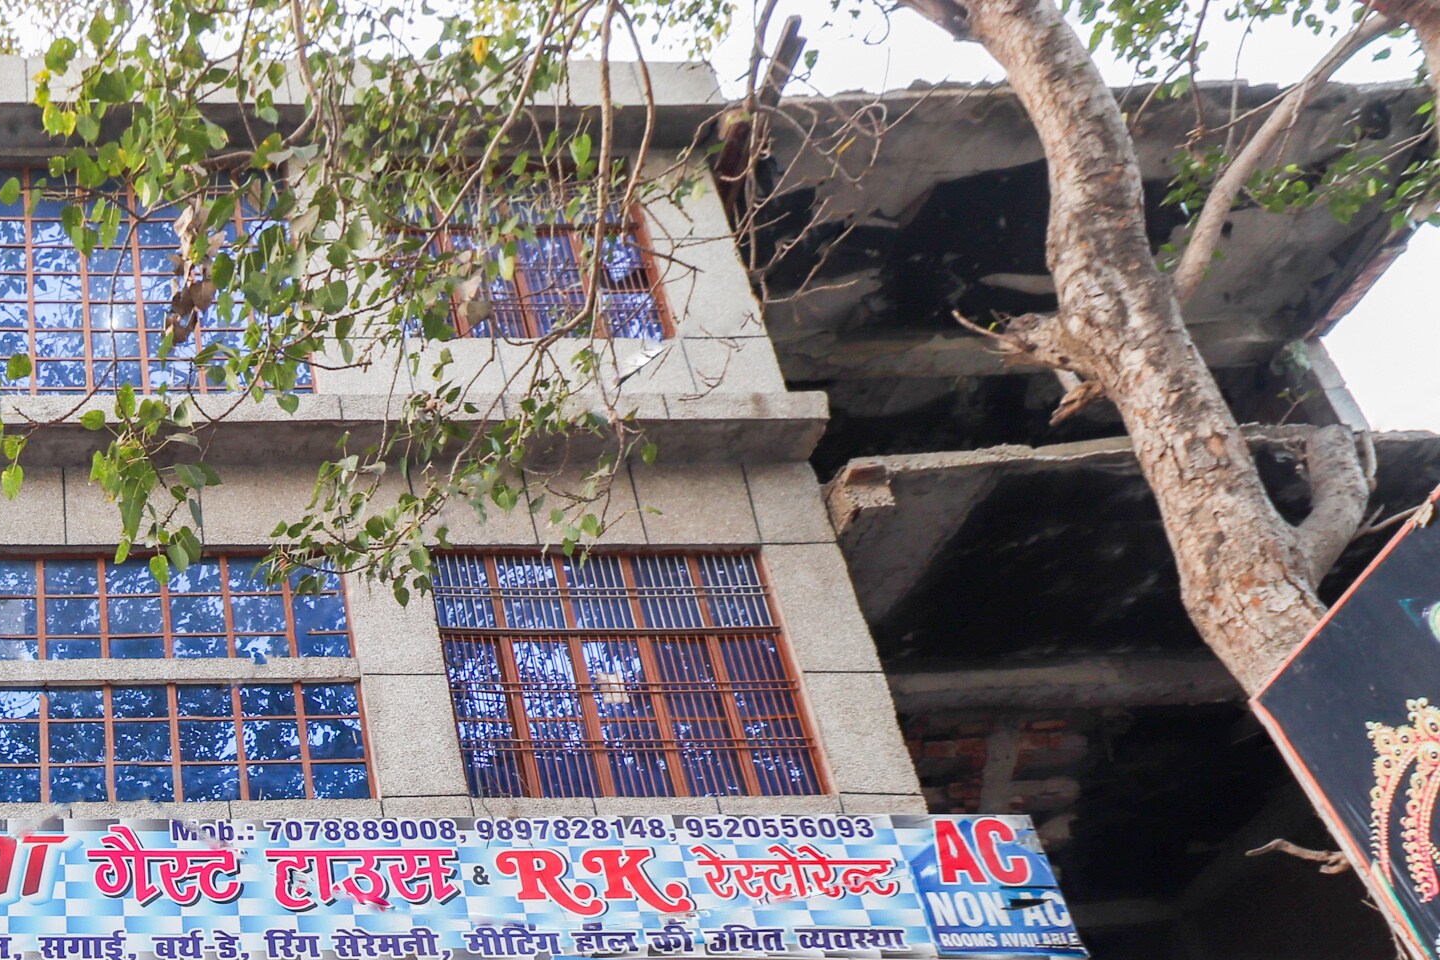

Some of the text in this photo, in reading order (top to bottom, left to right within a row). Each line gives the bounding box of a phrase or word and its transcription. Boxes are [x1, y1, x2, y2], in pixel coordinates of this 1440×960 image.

[269, 819, 466, 843] 7078889008,
[476, 818, 675, 842] 9897828148,
[689, 817, 874, 839] 9520556093
[934, 817, 1031, 885] AC
[472, 864, 490, 886] &
[926, 891, 1072, 928] NON AC
[705, 925, 786, 953] उचित
[938, 932, 998, 947] ROOMS
